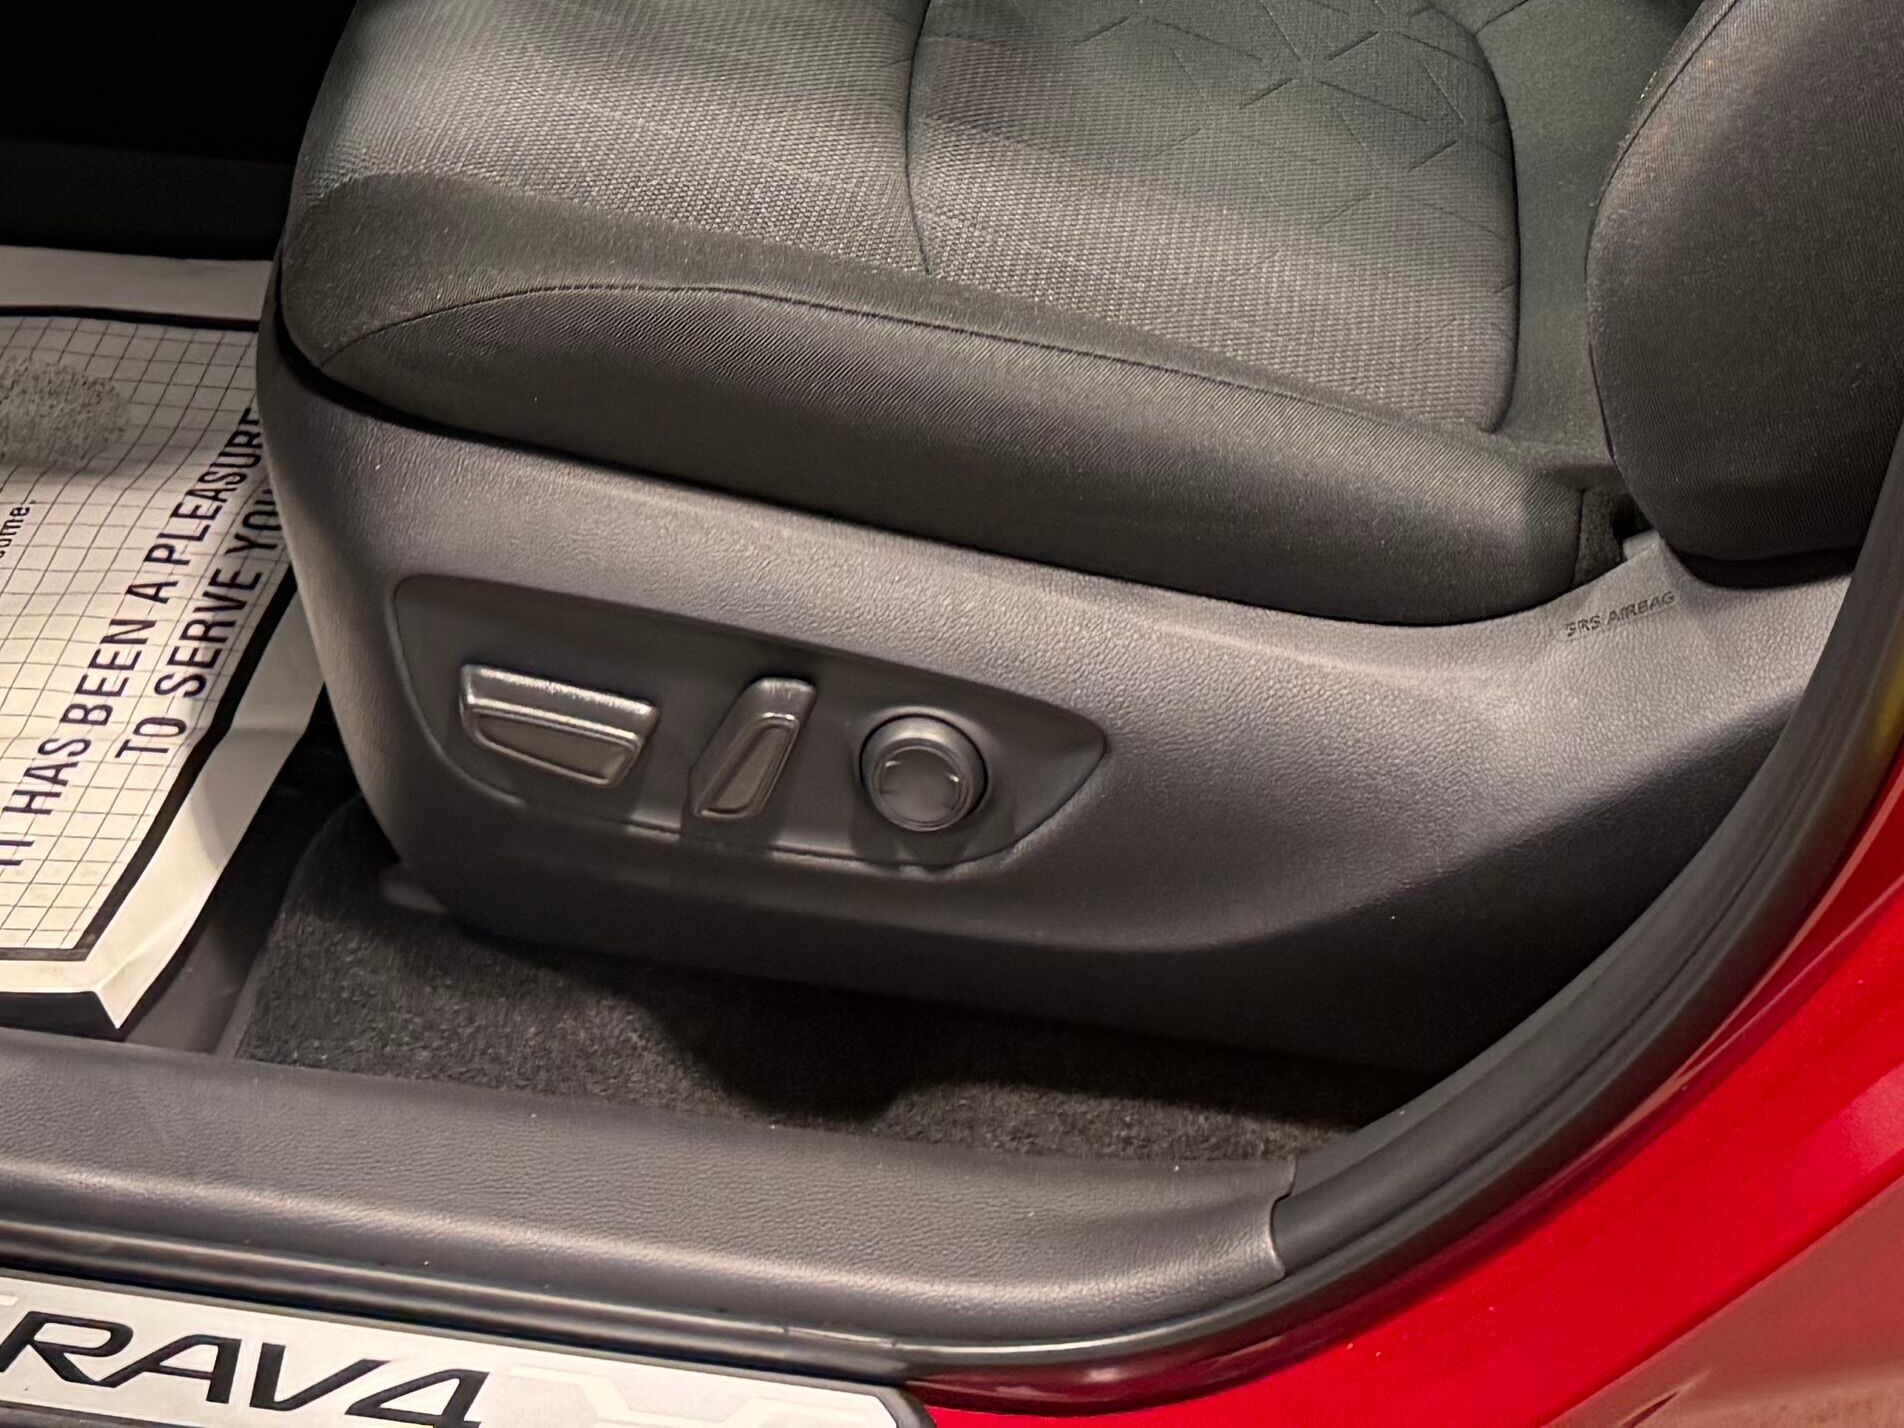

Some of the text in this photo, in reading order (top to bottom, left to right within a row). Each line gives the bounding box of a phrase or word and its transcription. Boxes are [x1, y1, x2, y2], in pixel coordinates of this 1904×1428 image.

[2, 737, 90, 815] HAS
[60, 618, 157, 727] BEEN
[125, 579, 178, 604] A
[115, 717, 188, 759] TO
[154, 568, 265, 699] SERVE
[1607, 590, 1675, 626] AIRBAG
